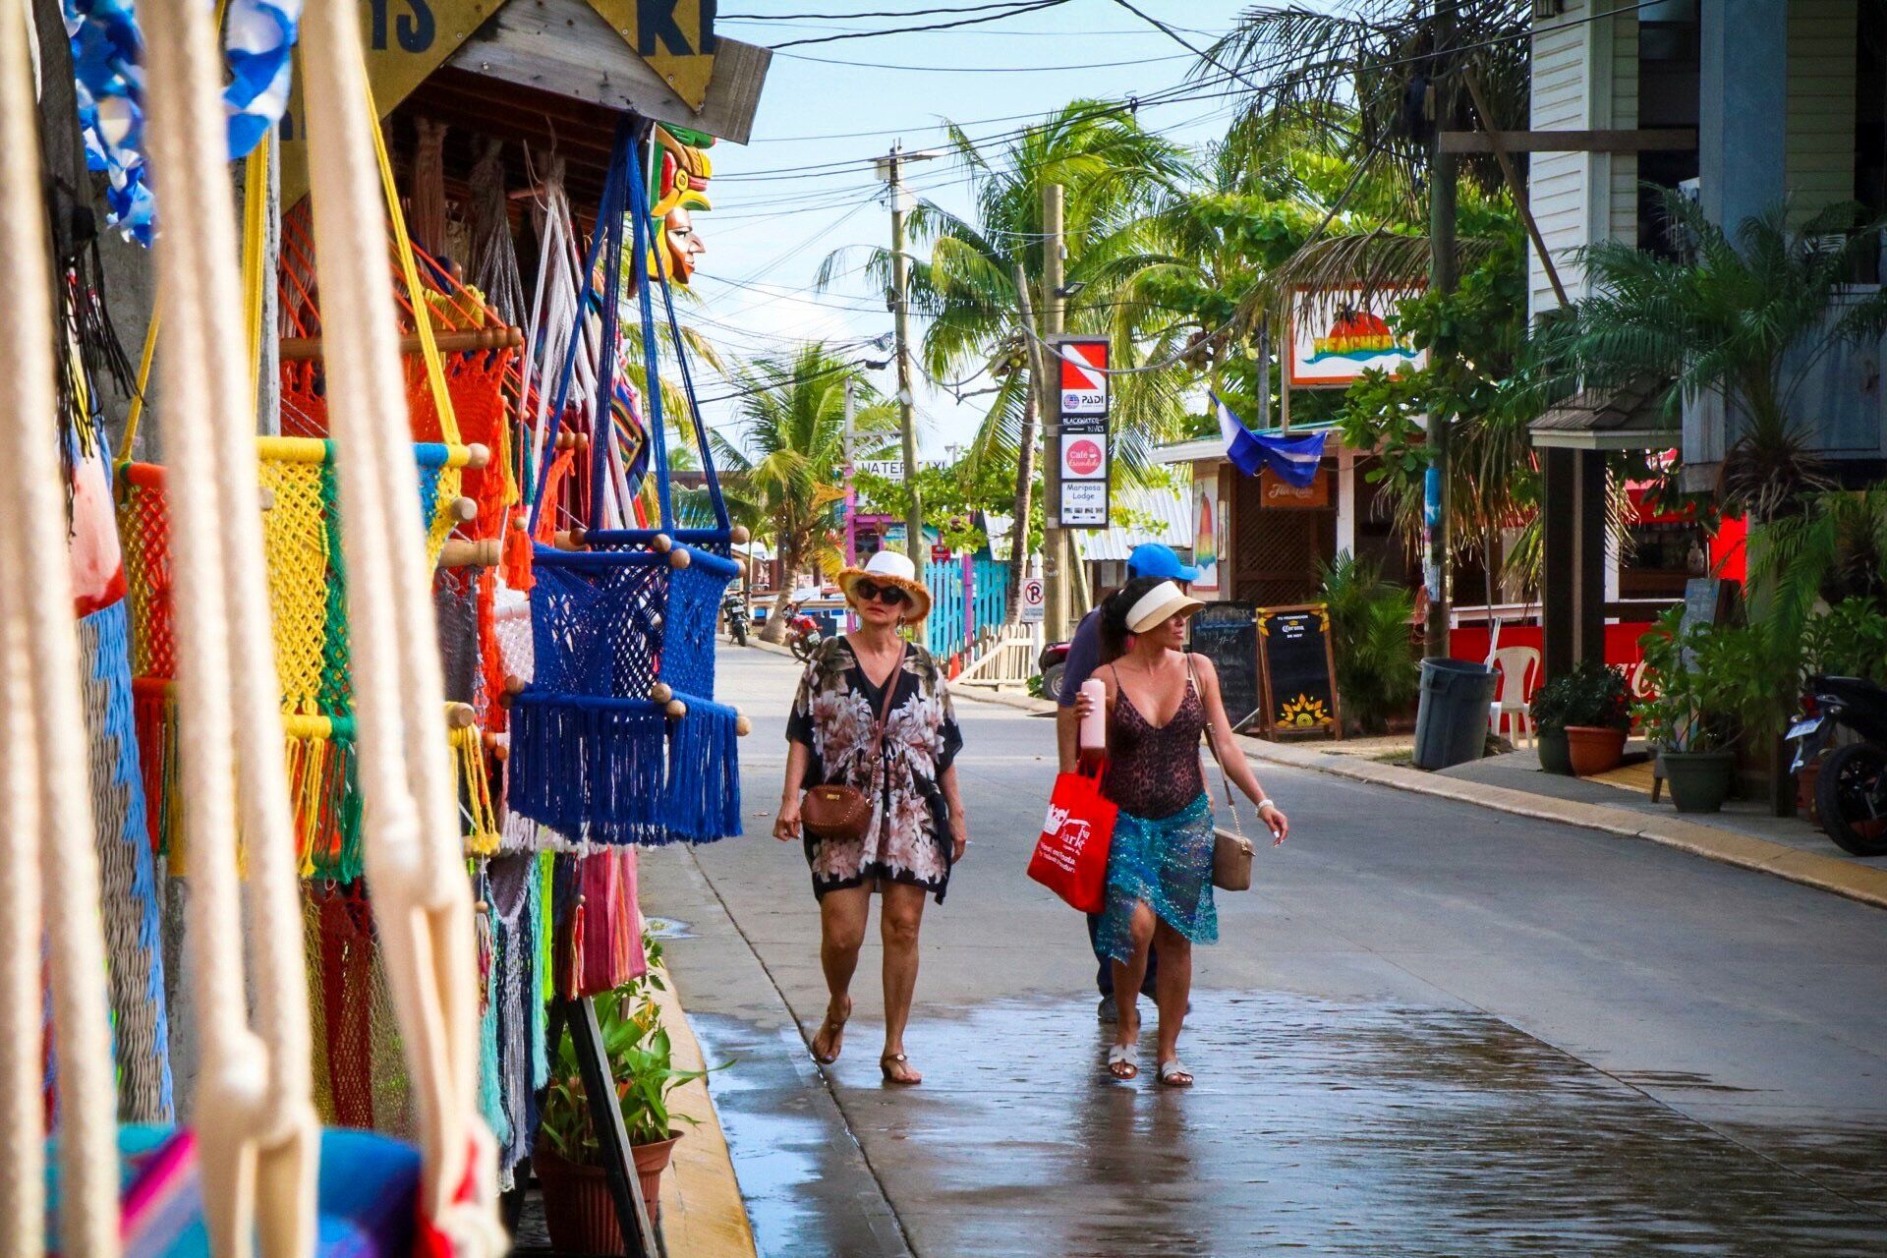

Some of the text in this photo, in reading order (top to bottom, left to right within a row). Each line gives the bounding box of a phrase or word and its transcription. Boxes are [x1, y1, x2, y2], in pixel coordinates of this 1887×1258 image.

[1082, 396, 1104, 404] PADI
[1067, 484, 1101, 493] Mariposa
[1073, 493, 1095, 501] Lodge
